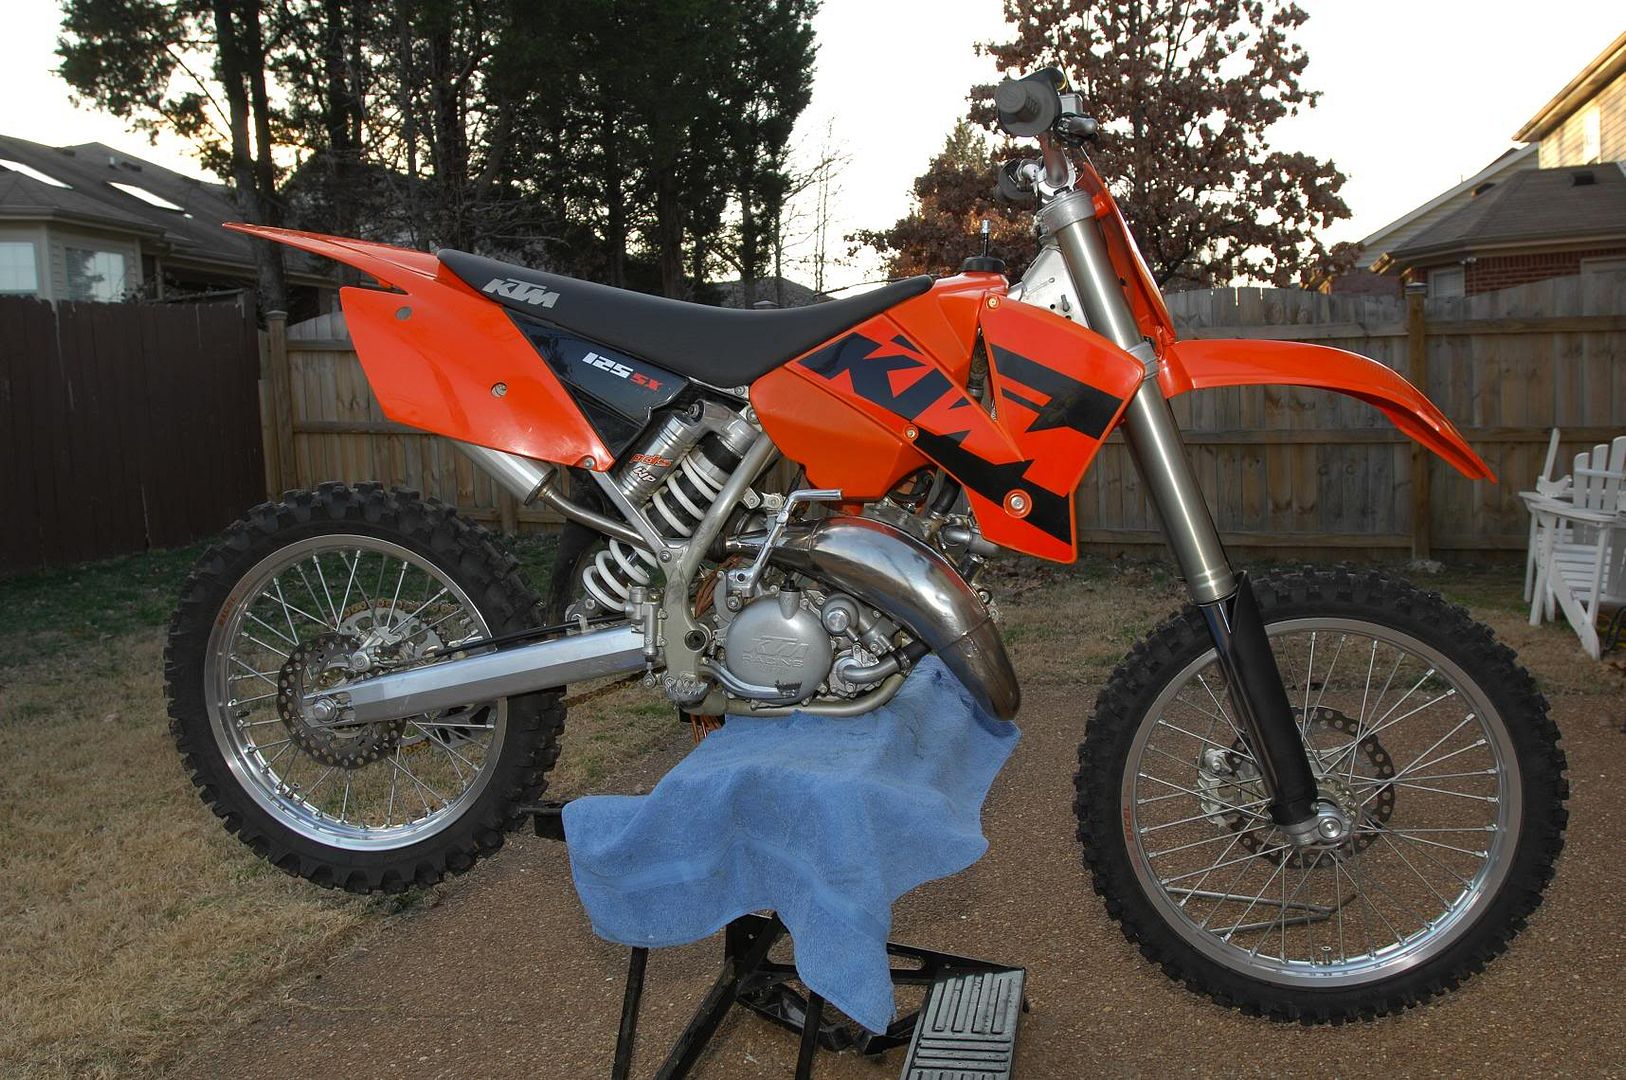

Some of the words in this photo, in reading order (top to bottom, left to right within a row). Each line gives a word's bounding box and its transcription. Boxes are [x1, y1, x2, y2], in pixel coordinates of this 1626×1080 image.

[482, 278, 560, 308] KTM
[582, 351, 633, 379] 125
[631, 373, 664, 392] SX
